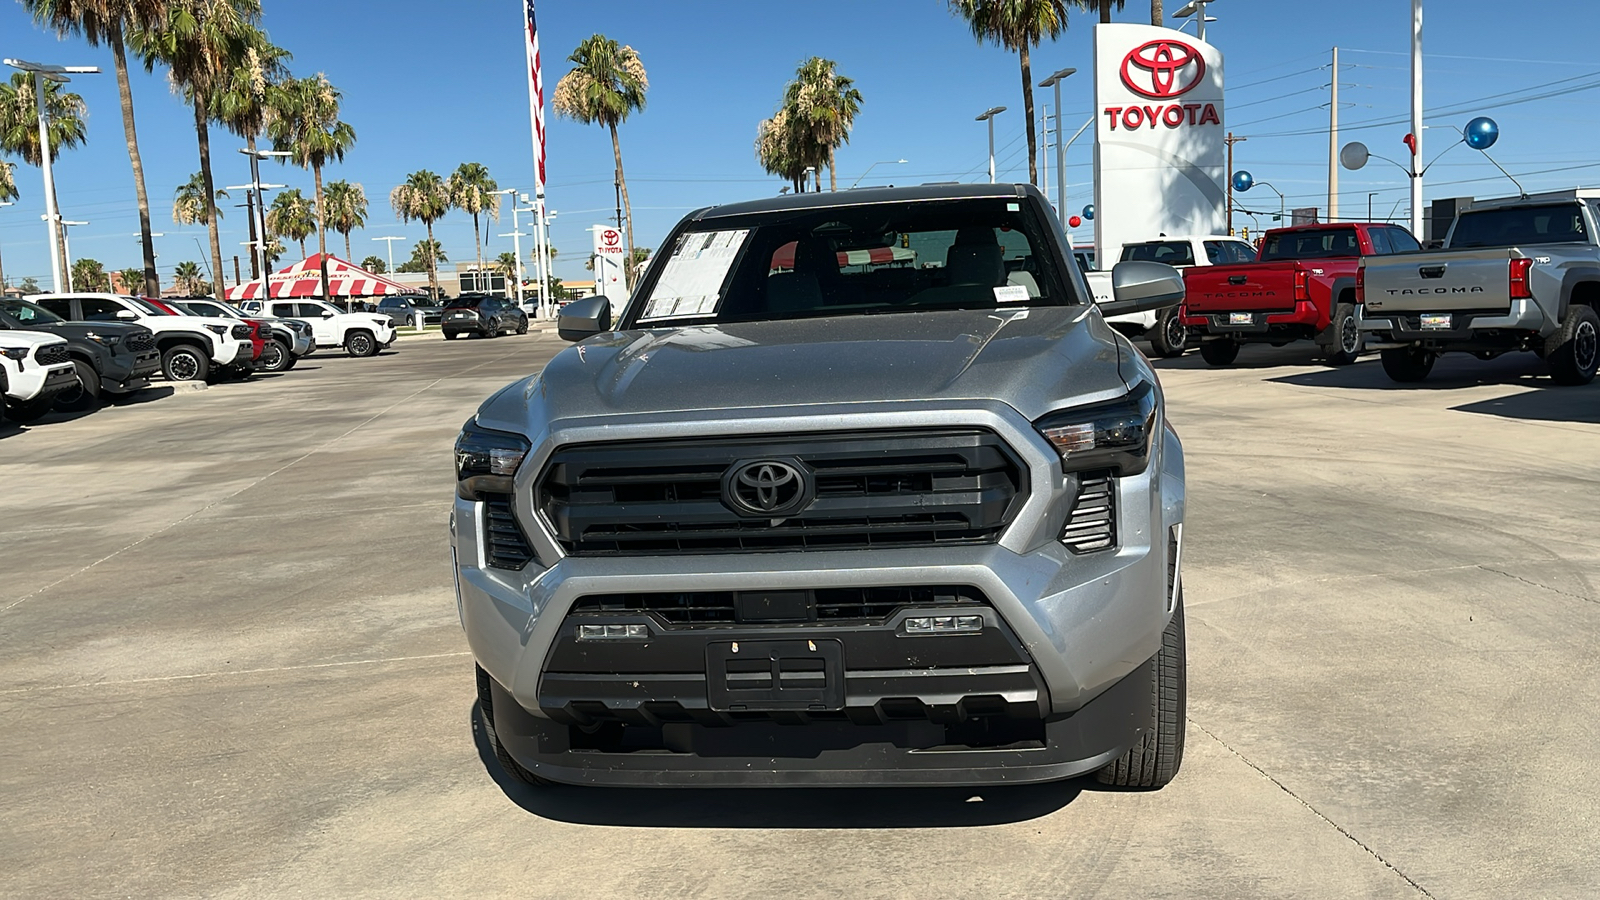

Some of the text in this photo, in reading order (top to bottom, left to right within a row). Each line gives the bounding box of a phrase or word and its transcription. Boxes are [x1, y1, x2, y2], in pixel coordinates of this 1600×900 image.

[1104, 104, 1220, 131] TOYOTA
[1535, 256, 1551, 264] TRD
[1386, 286, 1484, 296] TACOMA
